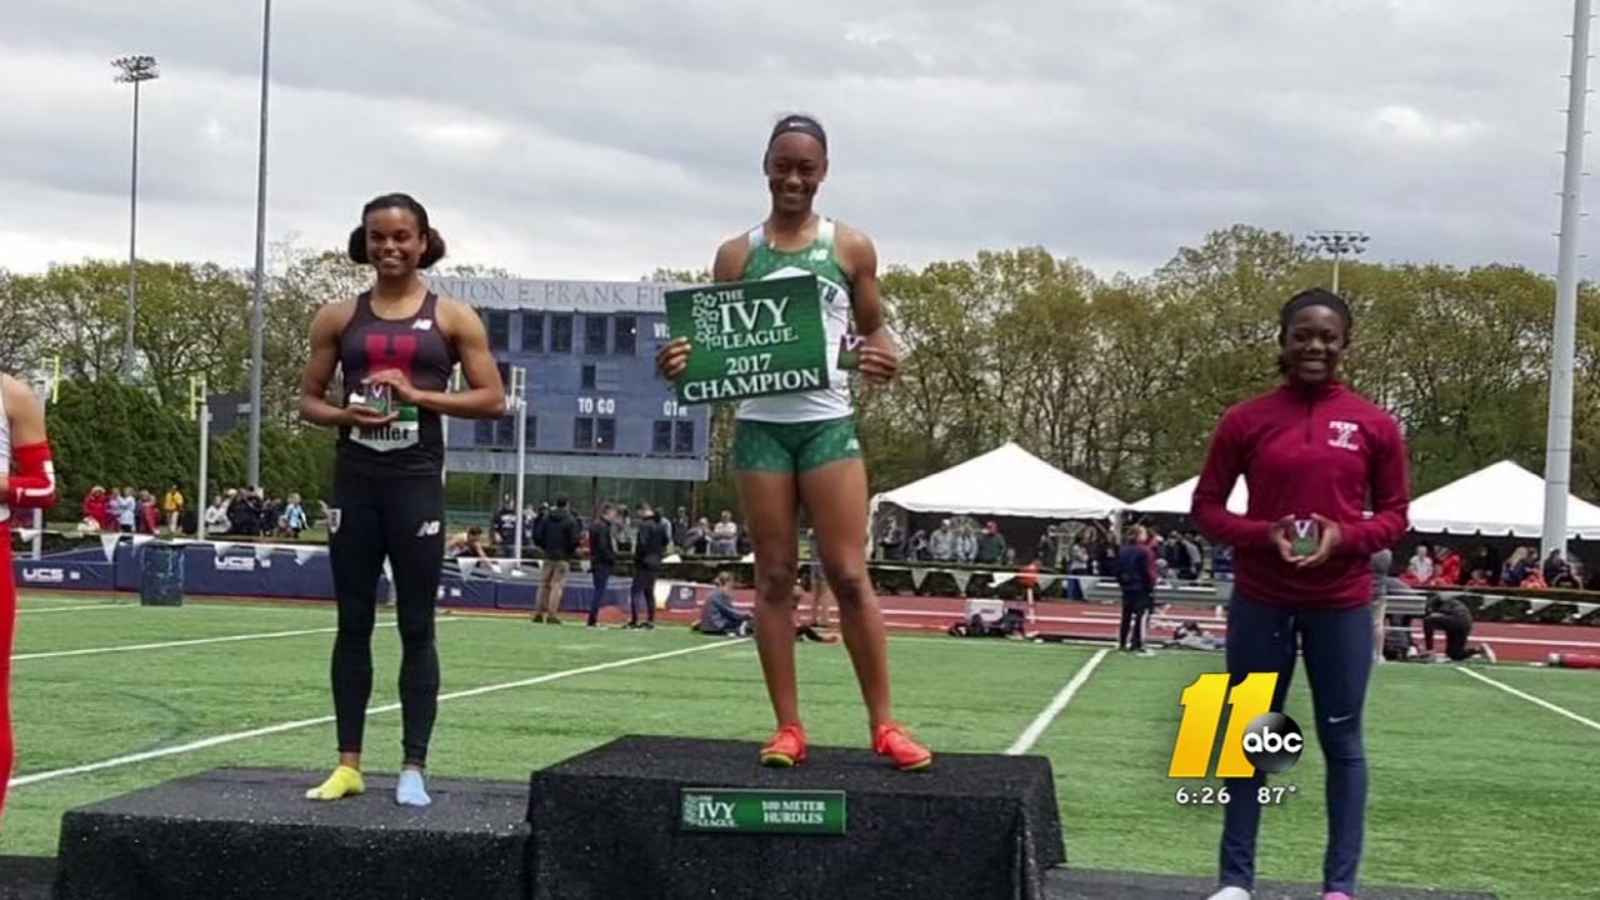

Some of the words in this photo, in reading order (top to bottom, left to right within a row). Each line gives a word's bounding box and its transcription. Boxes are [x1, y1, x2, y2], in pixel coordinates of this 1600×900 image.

[544, 283, 627, 305] FRANK
[716, 289, 745, 303] THE
[718, 296, 790, 334] IVY
[725, 353, 773, 375] 2017
[683, 368, 821, 401] CHAMPION
[577, 398, 593, 413] TO
[596, 399, 615, 414] GO
[699, 802, 736, 819] IVY
[782, 800, 826, 811] METER
[763, 811, 825, 824] HURDLES
